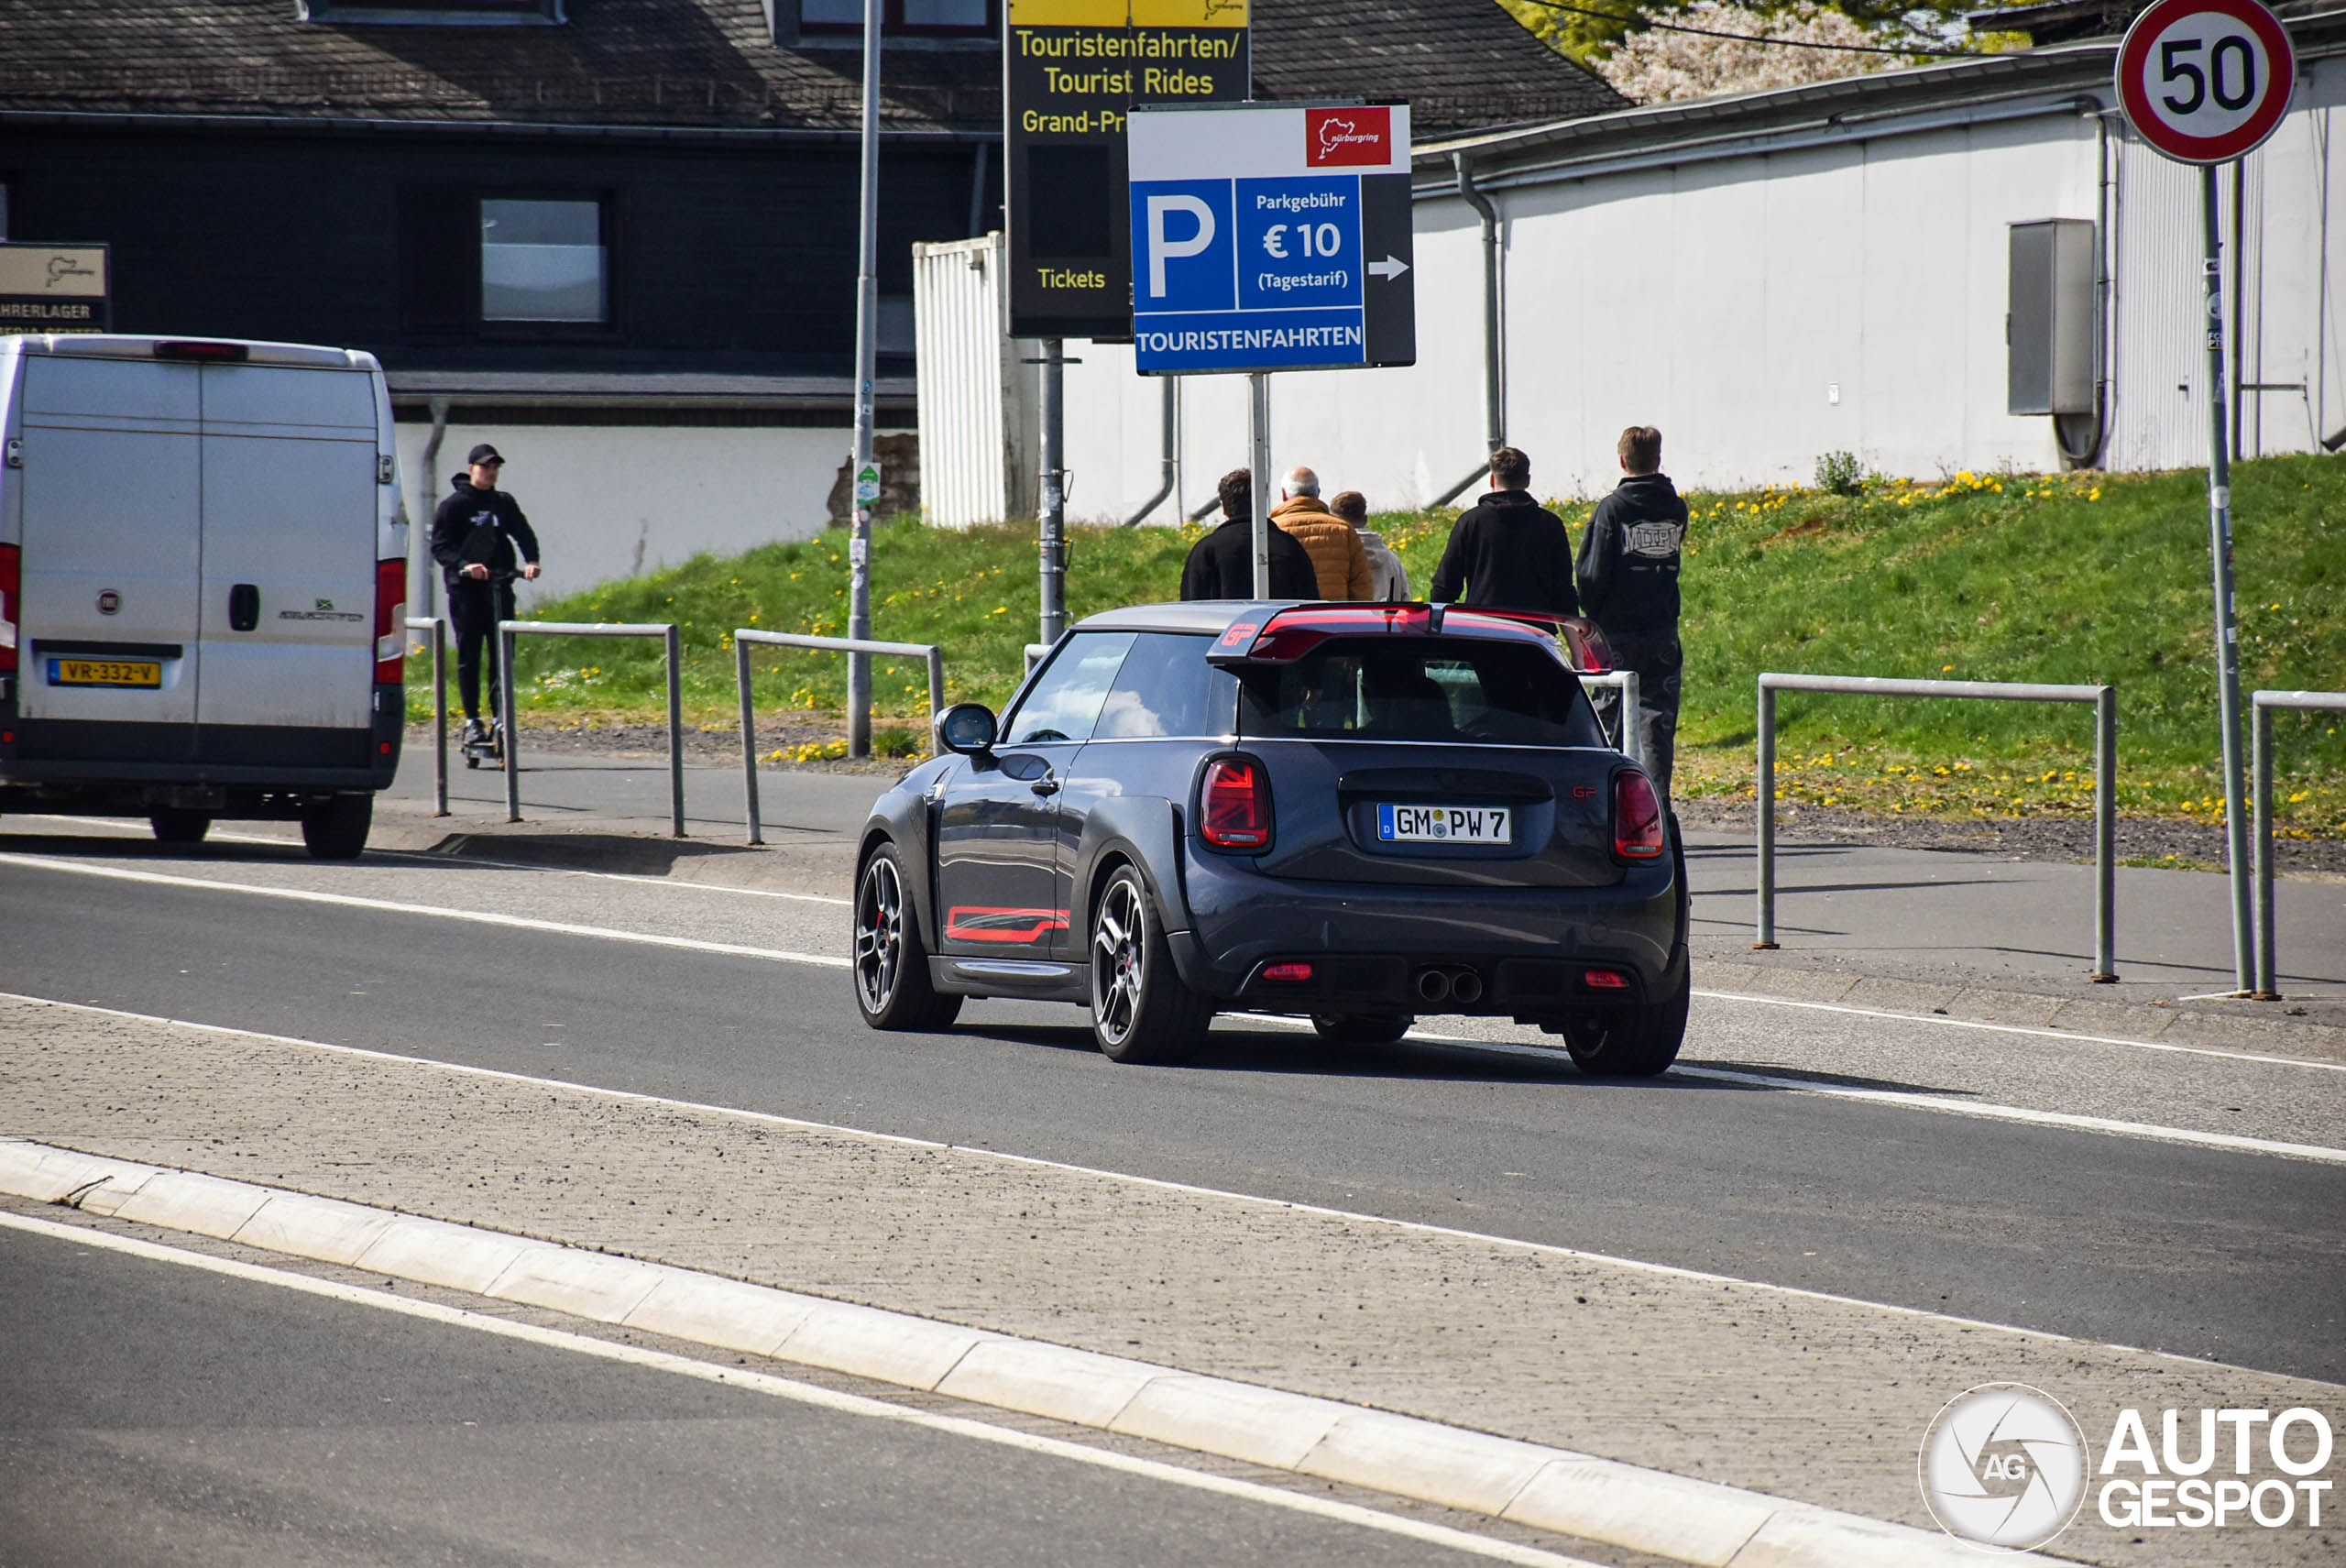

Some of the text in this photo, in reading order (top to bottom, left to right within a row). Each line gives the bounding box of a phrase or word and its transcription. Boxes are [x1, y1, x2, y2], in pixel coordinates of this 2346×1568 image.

[1016, 30, 1239, 59] Touristenfahrten/
[1044, 67, 1214, 94] Tourist Rides
[2161, 35, 2255, 115] 50
[1331, 132, 1379, 144] nürburgring
[1256, 192, 1346, 213] Parkgebühr
[1146, 194, 1216, 298] P
[1263, 223, 1342, 259] € 10
[1037, 269, 1105, 289] Tickets
[1257, 270, 1349, 291] (Tagestarif)
[1136, 325, 1362, 353] TOURISTENFAHRTEN
[1222, 623, 1258, 646] GP
[67, 663, 152, 681] VR-332-V
[1573, 785, 1598, 798] GP
[1397, 809, 1431, 835] GM
[1451, 810, 1483, 837] PW
[1489, 812, 1505, 838] 7
